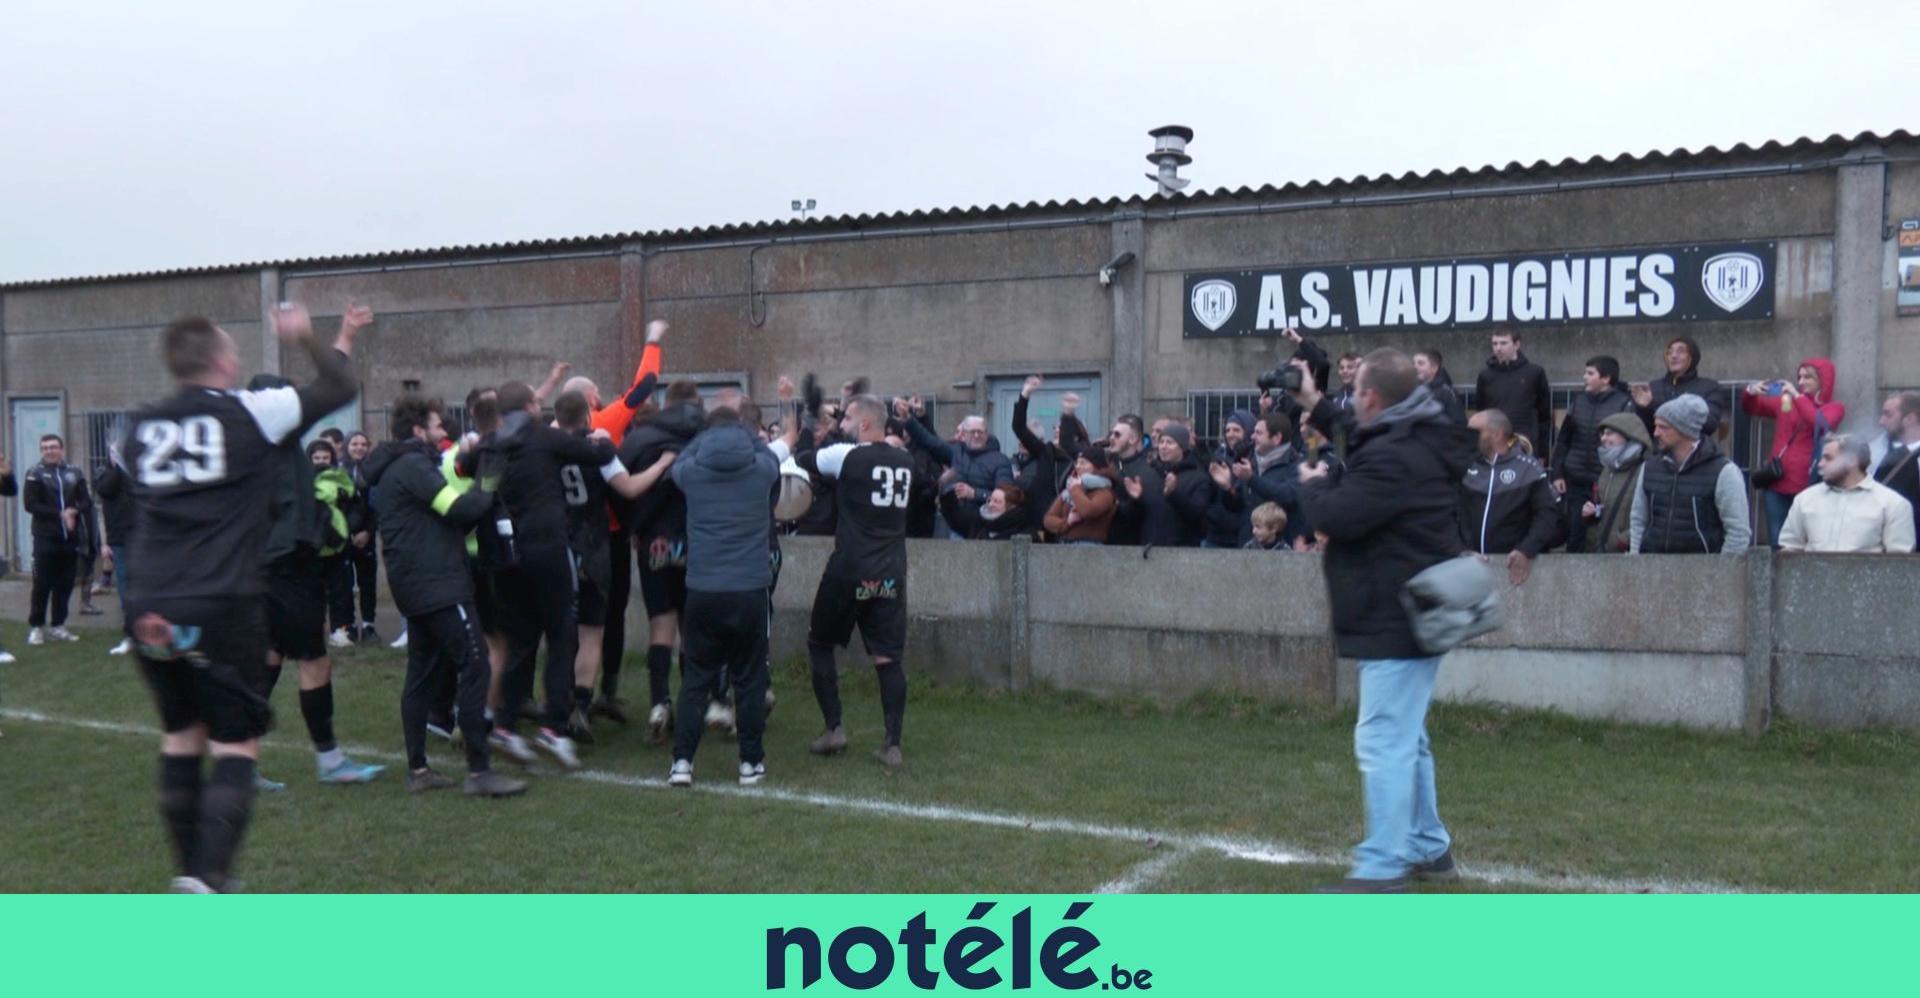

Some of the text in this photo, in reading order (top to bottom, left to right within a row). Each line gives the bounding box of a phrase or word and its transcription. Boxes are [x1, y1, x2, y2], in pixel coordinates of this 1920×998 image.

[1255, 253, 1675, 330] A.S. VAUDIGNIES
[136, 414, 227, 486] 29
[871, 465, 911, 508] 33
